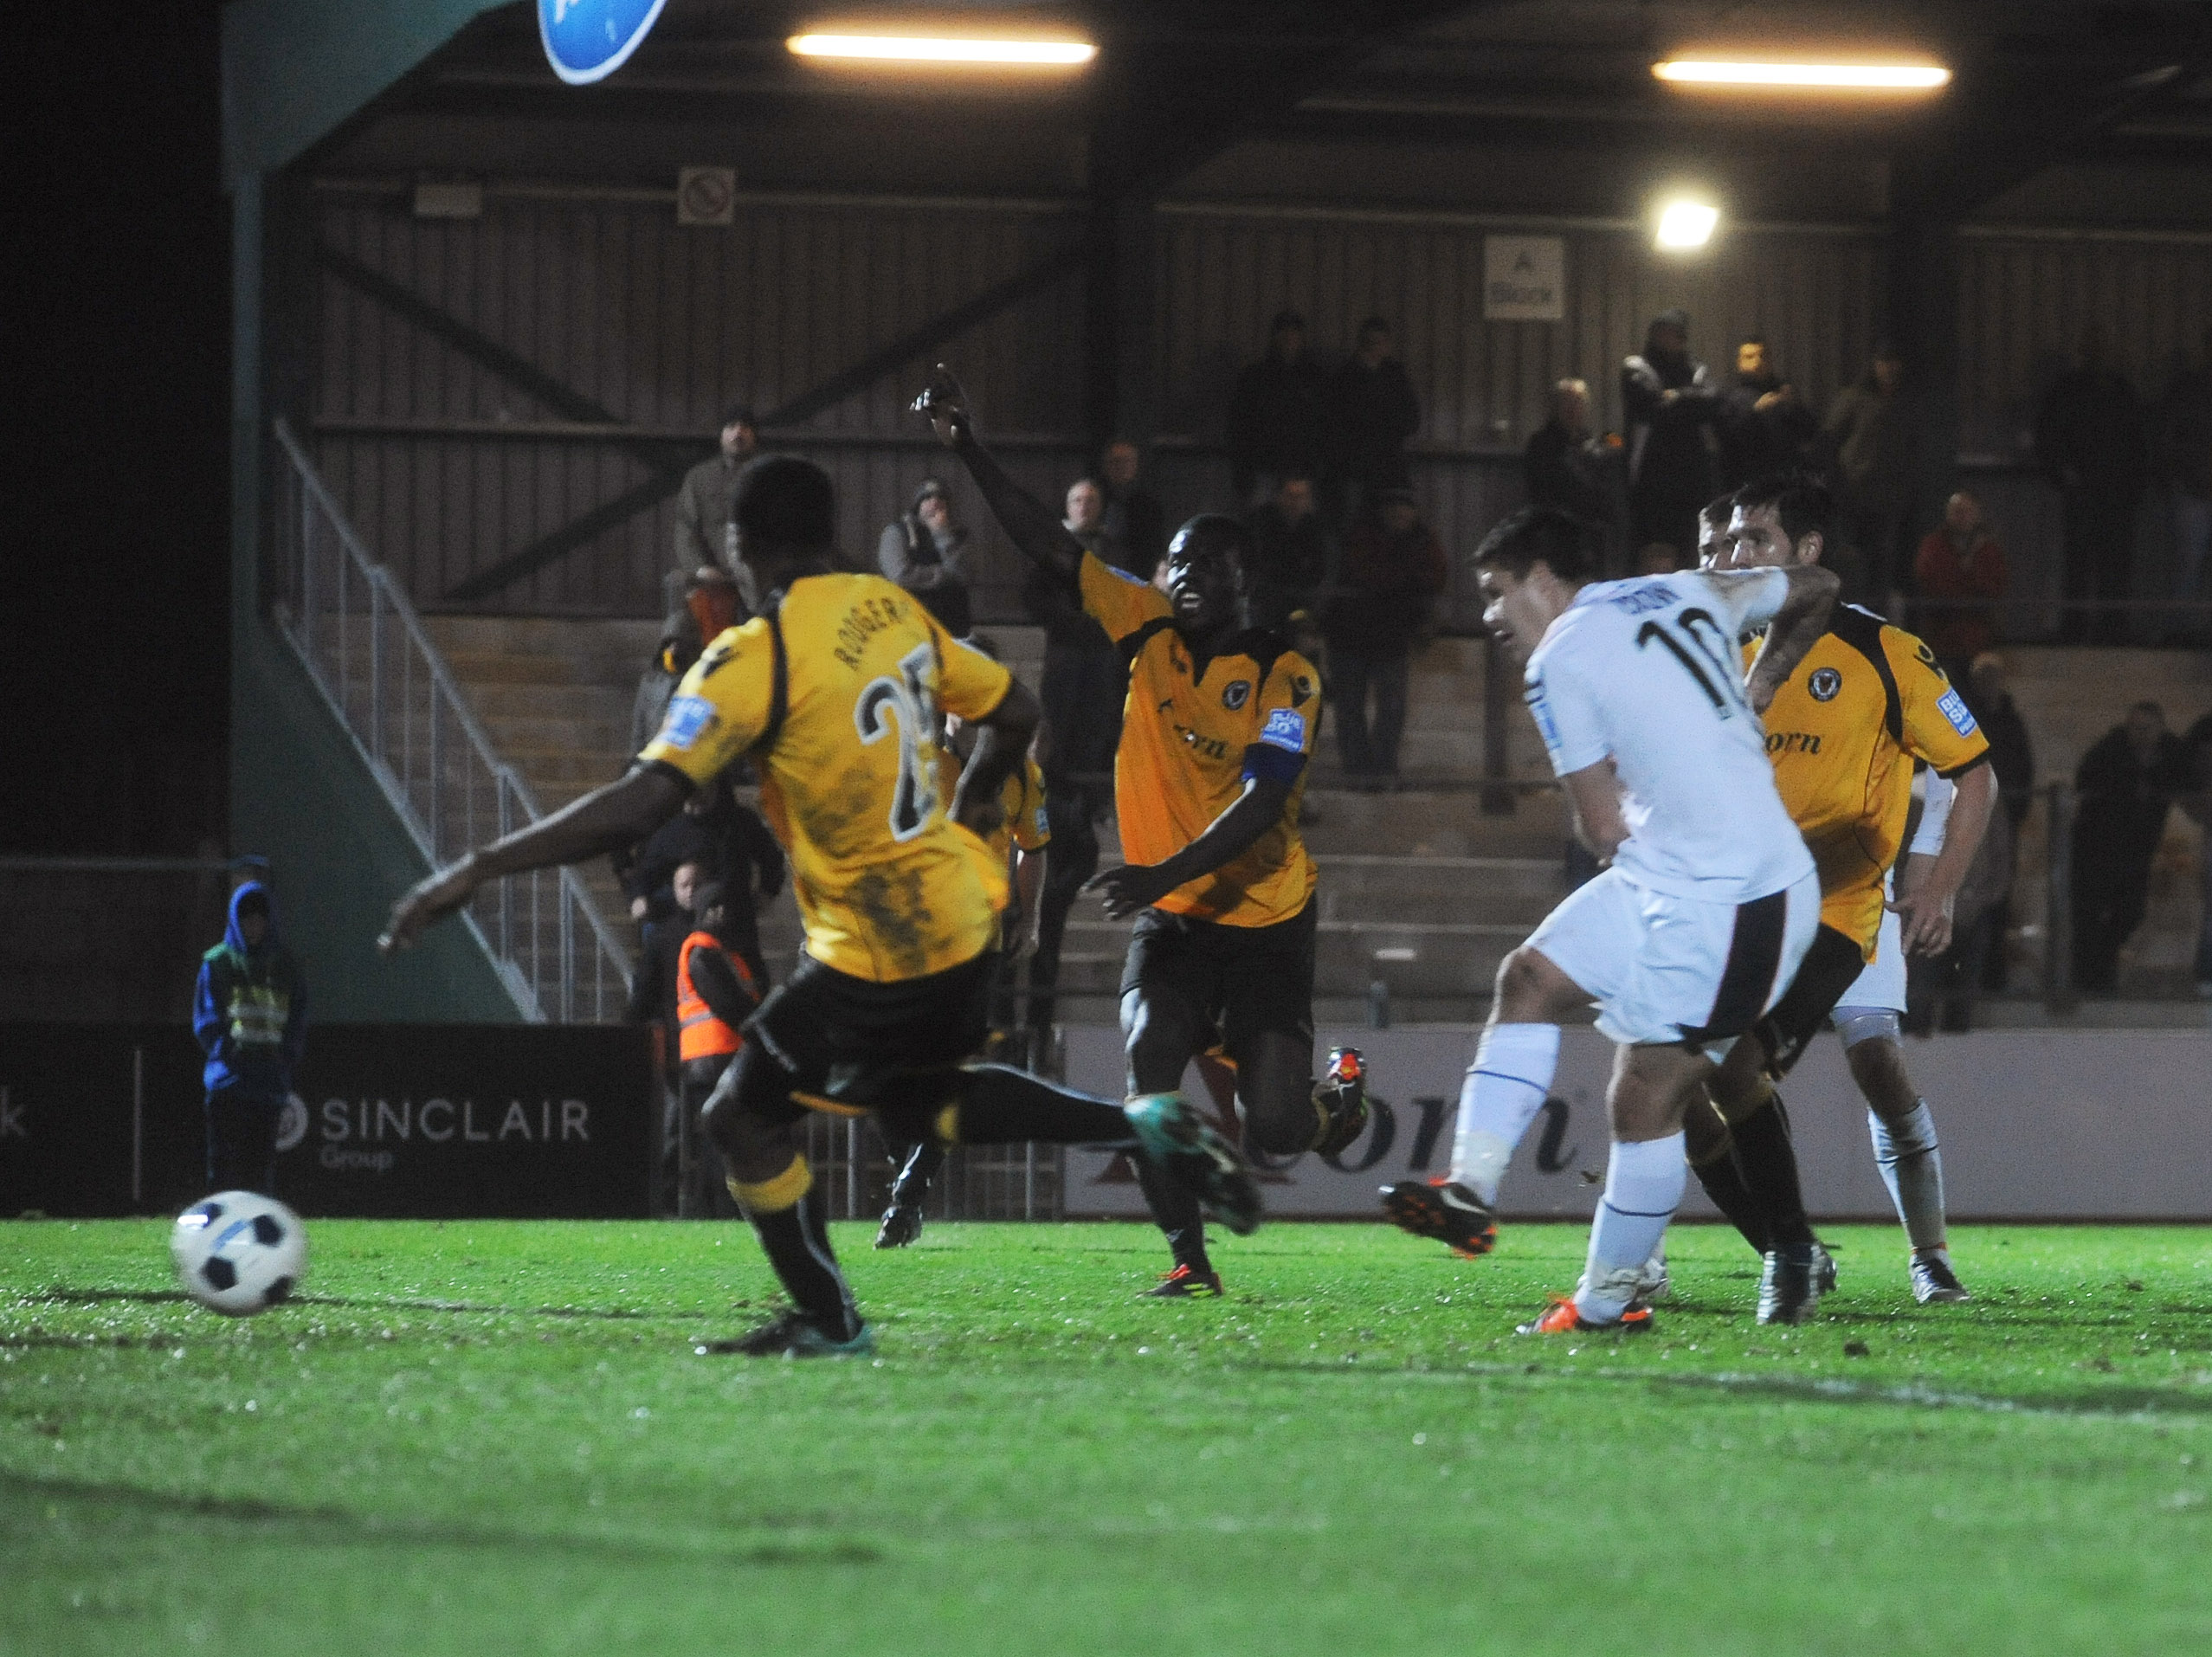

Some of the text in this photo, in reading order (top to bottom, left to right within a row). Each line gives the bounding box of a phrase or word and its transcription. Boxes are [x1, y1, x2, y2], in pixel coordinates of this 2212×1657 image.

[1635, 607, 1751, 721] 10
[1764, 732, 1821, 755] orn
[321, 1098, 590, 1142] SINCLAIR
